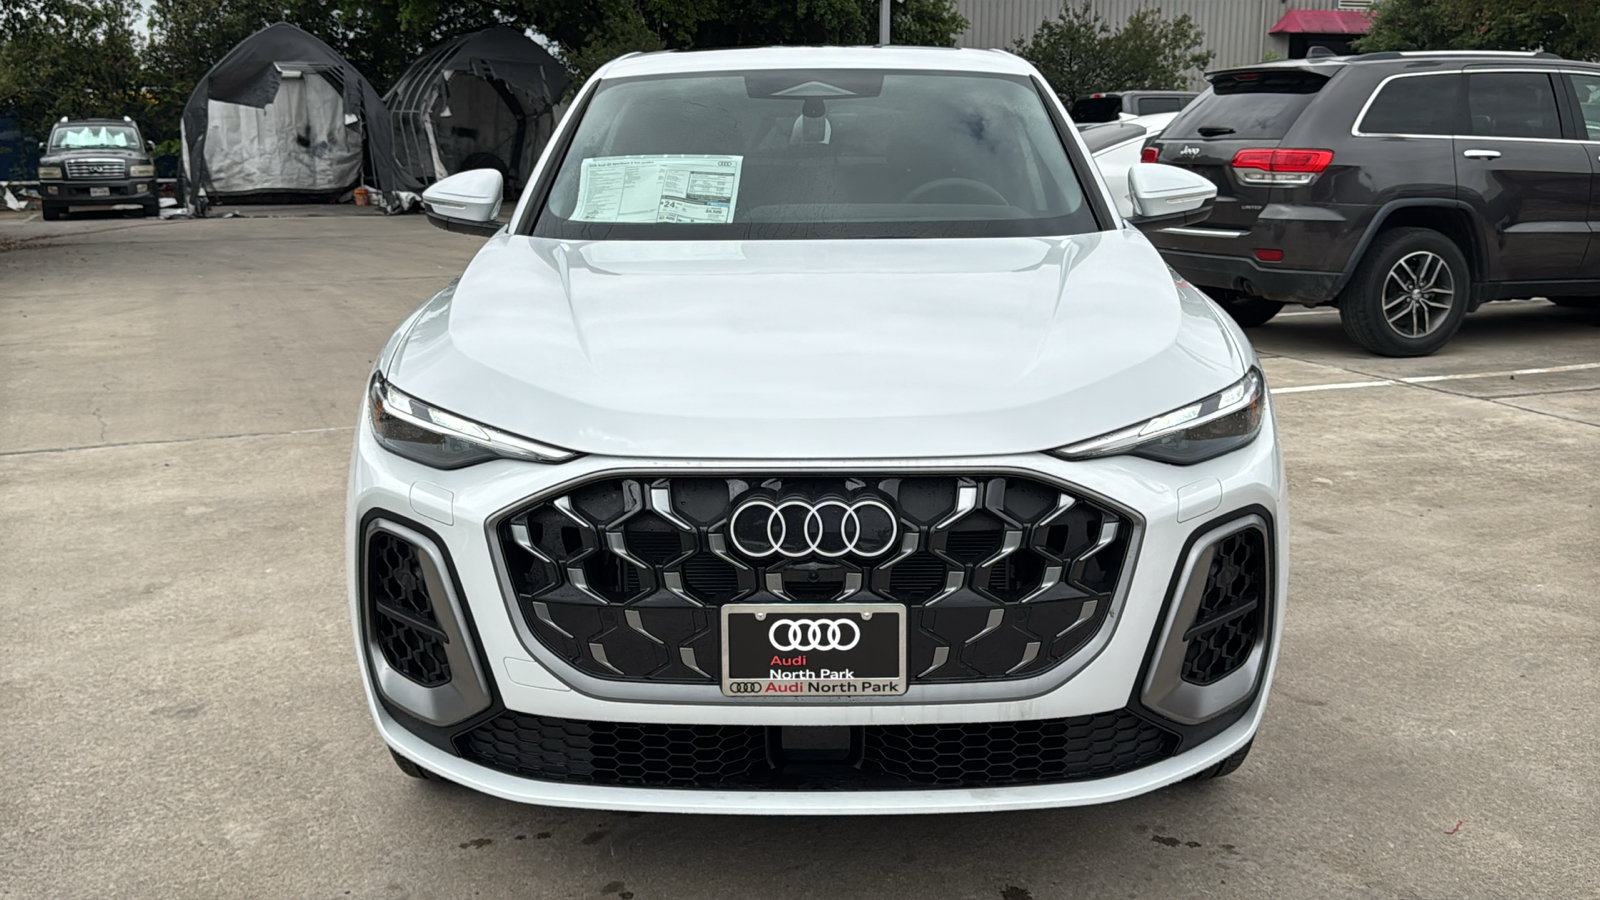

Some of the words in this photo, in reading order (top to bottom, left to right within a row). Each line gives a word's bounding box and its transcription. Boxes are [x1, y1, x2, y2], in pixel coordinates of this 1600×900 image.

[1180, 145, 1200, 159] Jeep
[770, 655, 806, 666] Audi
[770, 669, 816, 680] North
[820, 669, 855, 680] Park
[765, 682, 803, 693] Audi
[808, 682, 857, 693] North
[862, 682, 899, 692] Park
